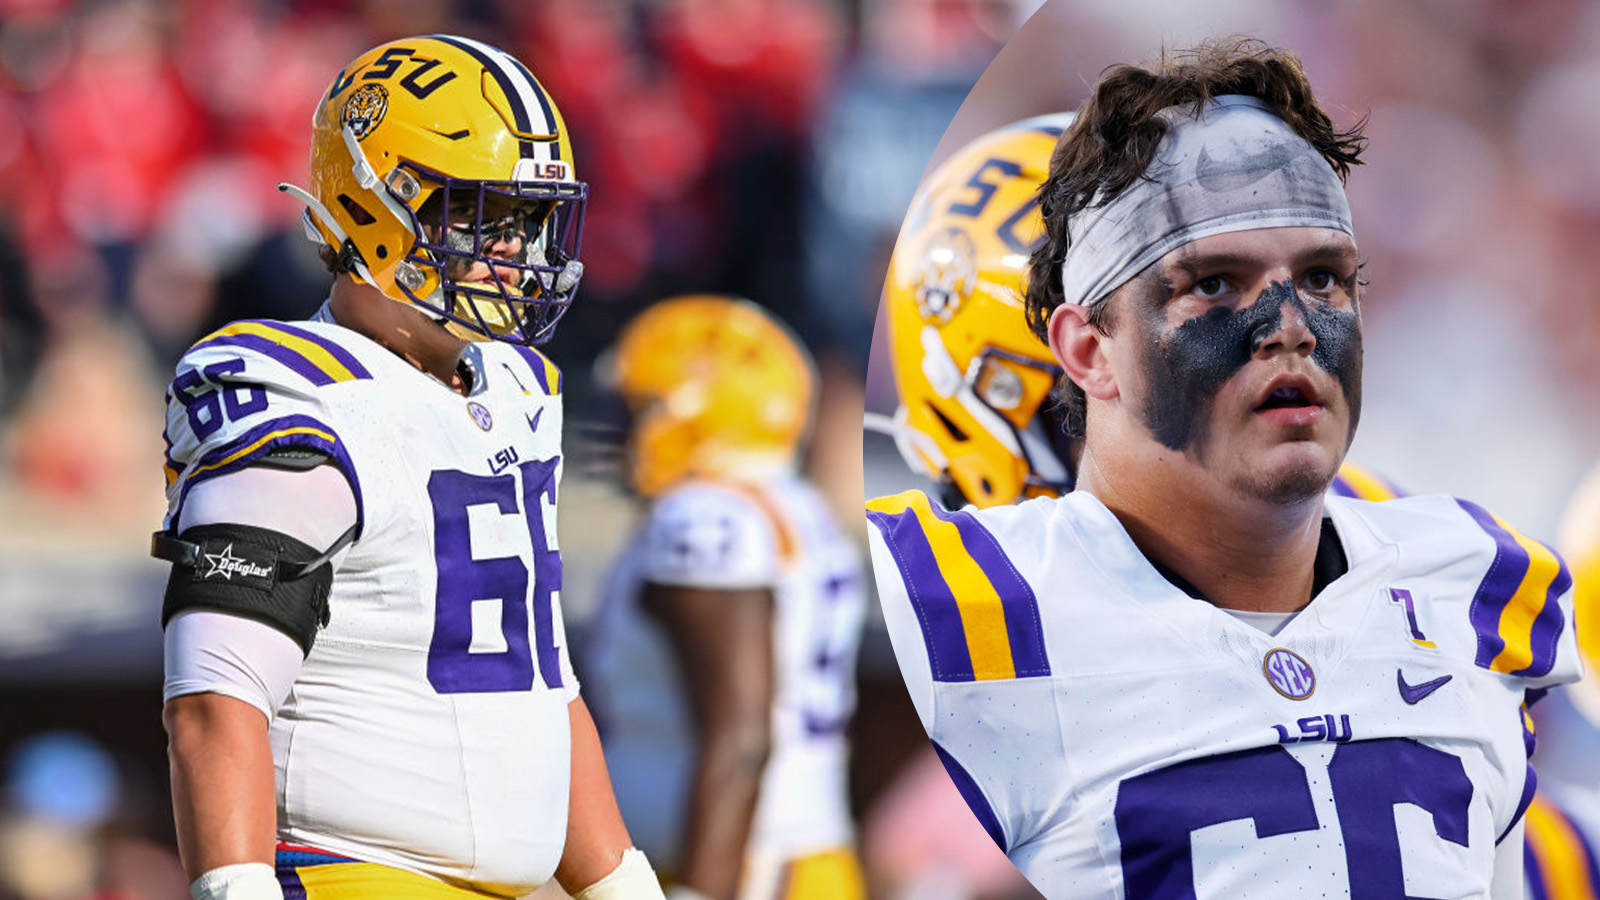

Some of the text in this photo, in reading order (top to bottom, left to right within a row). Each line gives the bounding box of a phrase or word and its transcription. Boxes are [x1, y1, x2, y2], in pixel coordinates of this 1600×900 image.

[328, 47, 458, 100] LSU
[534, 163, 566, 180] LSU
[908, 157, 1051, 256] SU
[172, 357, 270, 441] 66
[487, 445, 519, 475] LSU
[218, 557, 268, 577] Douglas
[1388, 587, 1438, 649] 1
[1266, 650, 1313, 698] SEC
[1271, 714, 1353, 743] LSU
